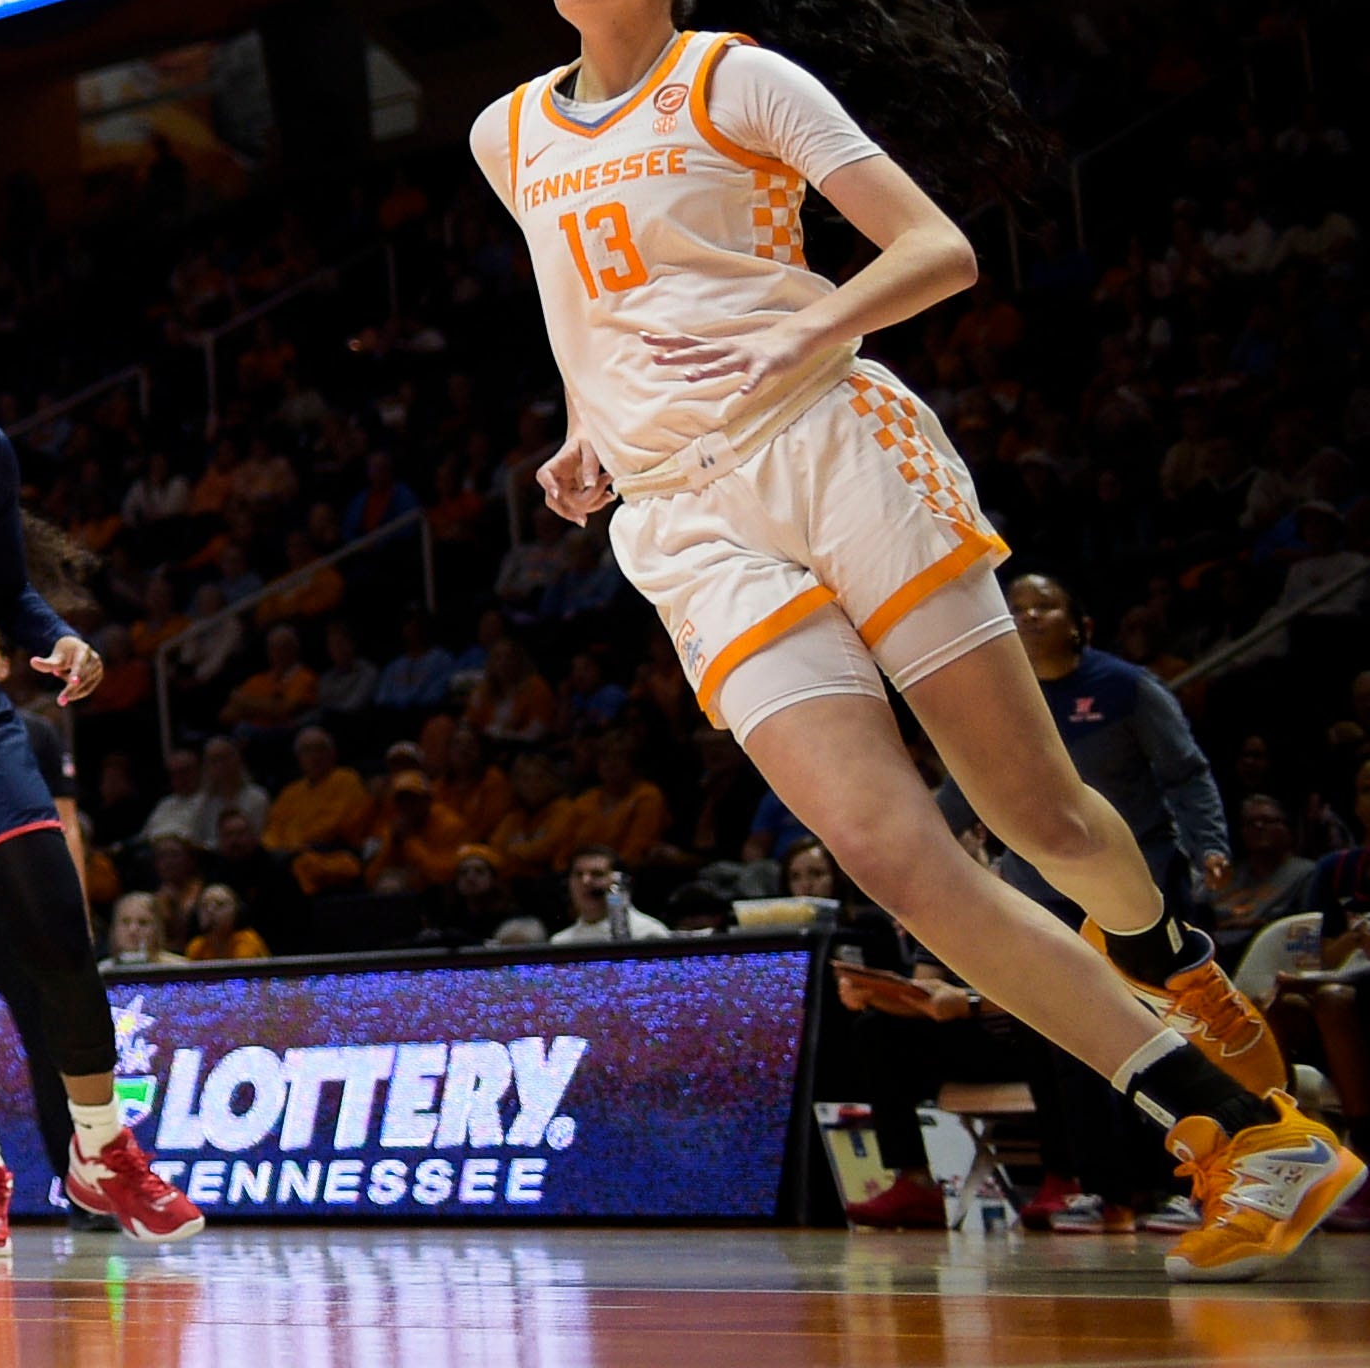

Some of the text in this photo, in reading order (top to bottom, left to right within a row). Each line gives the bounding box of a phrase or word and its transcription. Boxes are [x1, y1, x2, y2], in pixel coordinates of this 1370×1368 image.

[522, 146, 688, 213] TENNESSEE
[558, 200, 648, 300] 13
[149, 1158, 547, 1205] TENNESSEE
